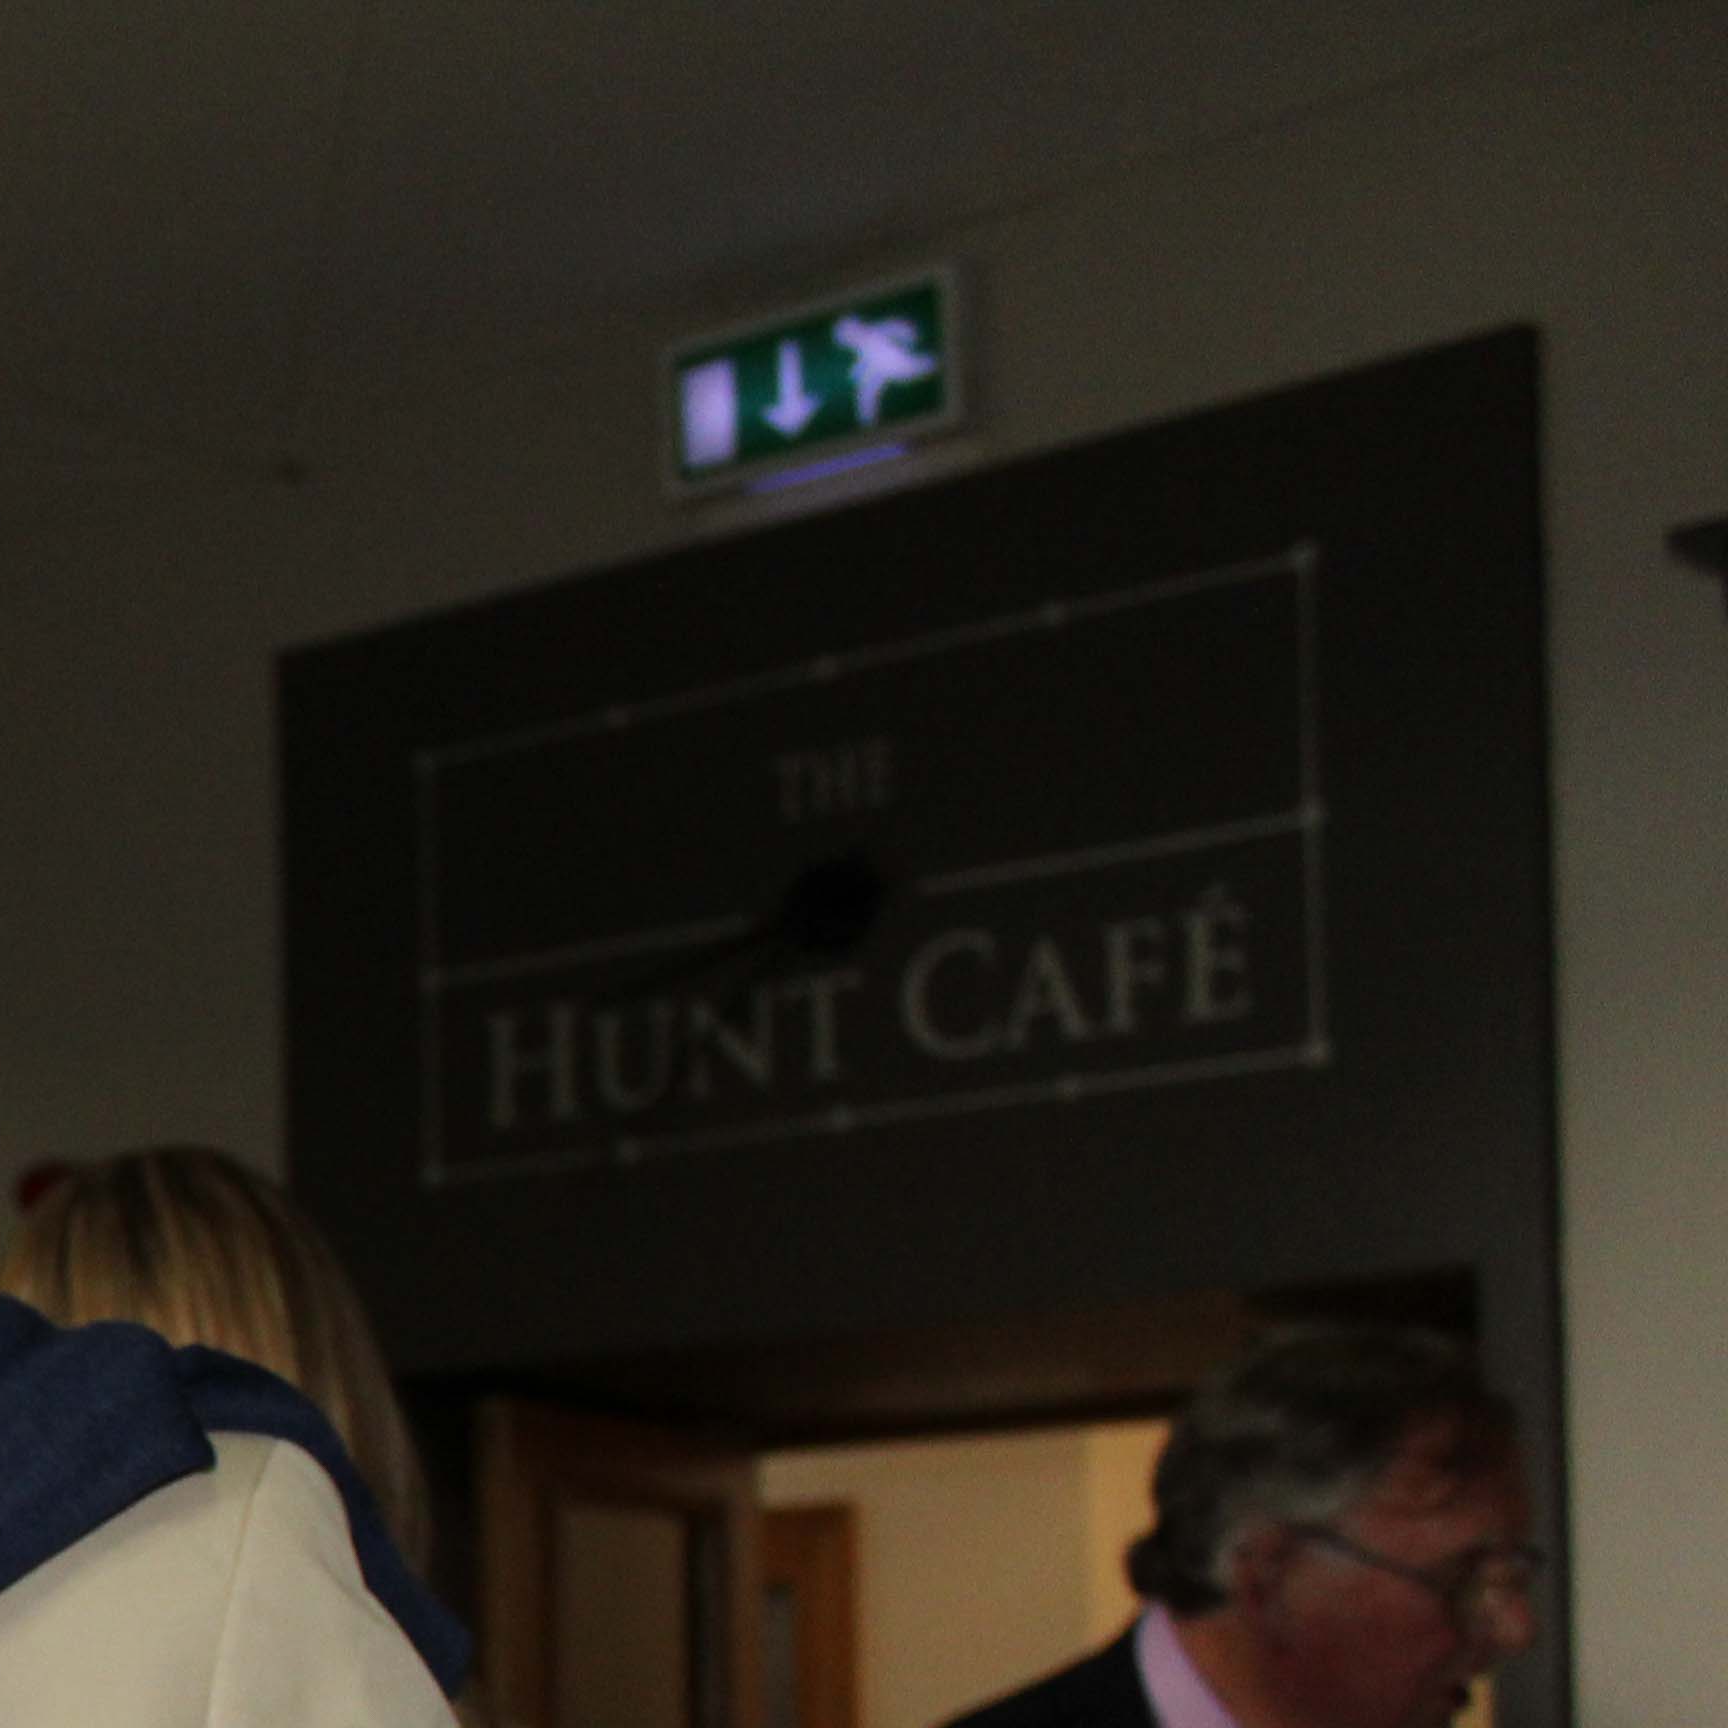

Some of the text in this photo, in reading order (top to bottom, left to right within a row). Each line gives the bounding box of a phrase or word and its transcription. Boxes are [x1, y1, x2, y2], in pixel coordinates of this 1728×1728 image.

[775, 738, 898, 823] THE
[484, 880, 1256, 1130] HUNT CAFÉ
